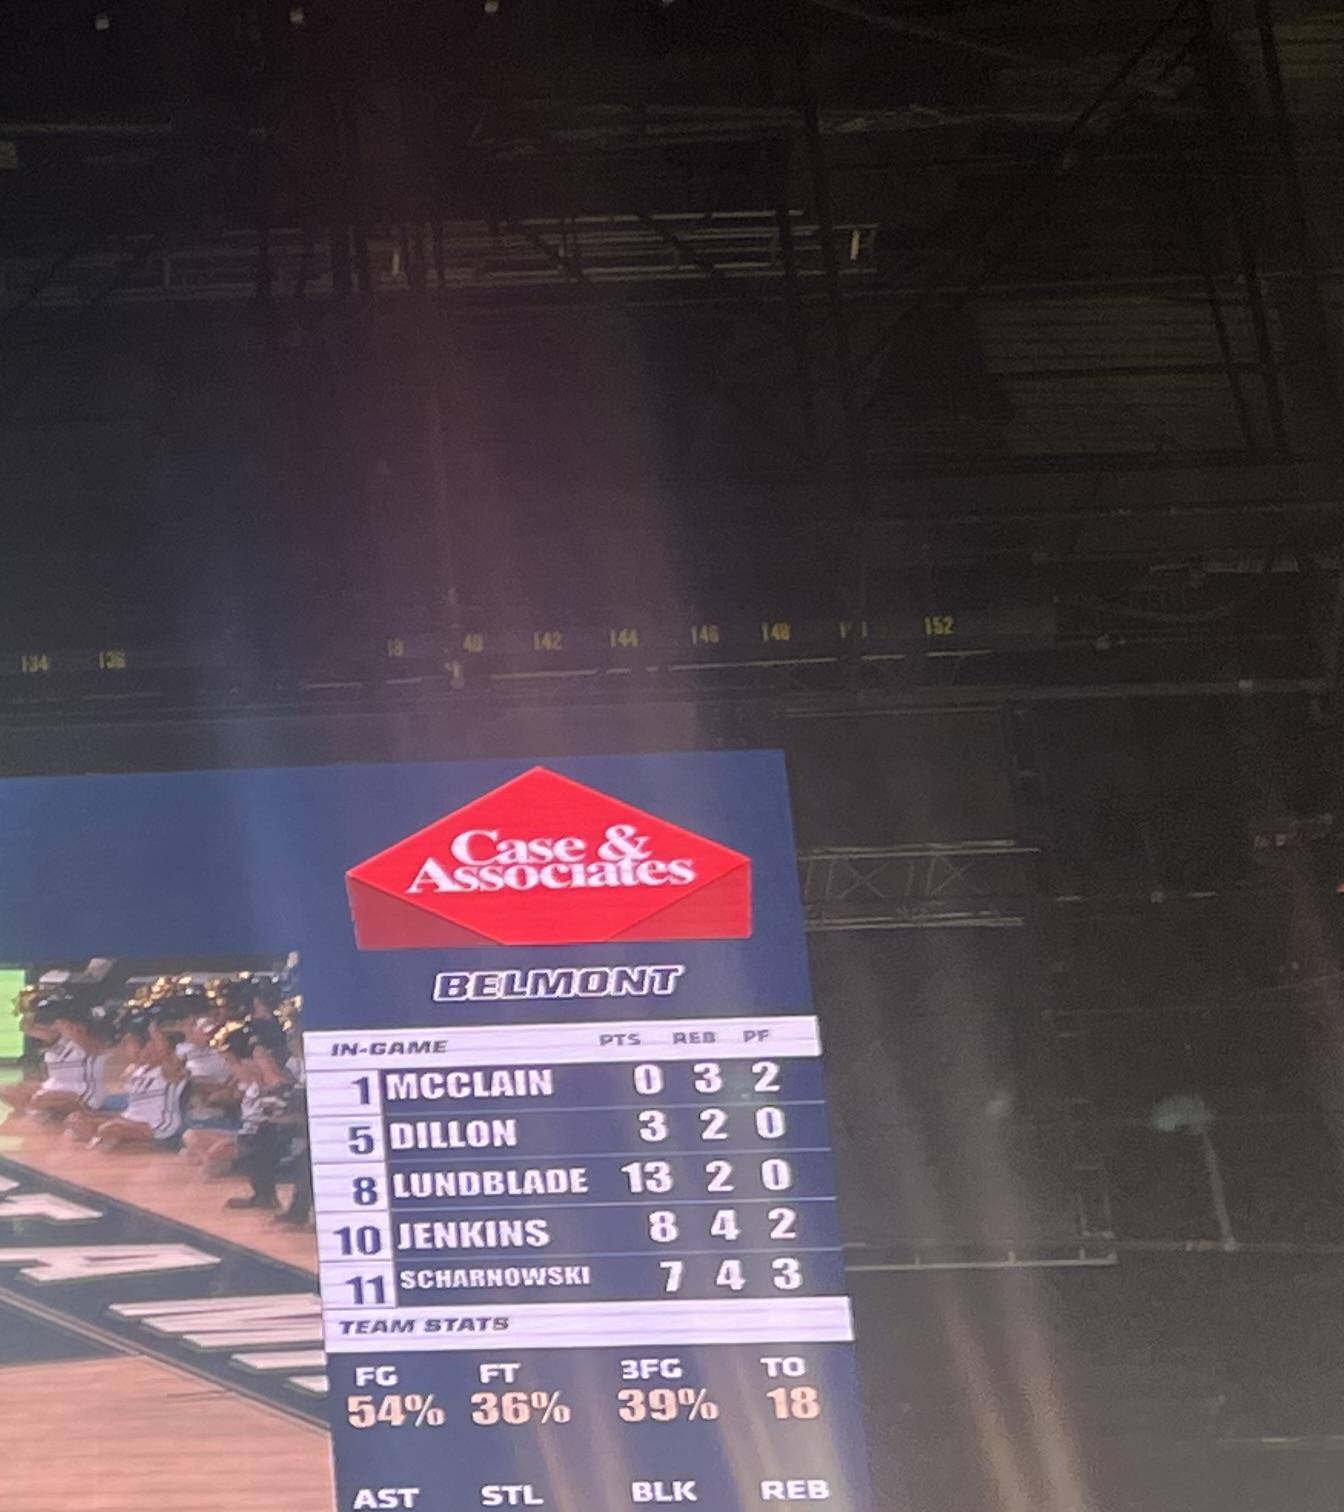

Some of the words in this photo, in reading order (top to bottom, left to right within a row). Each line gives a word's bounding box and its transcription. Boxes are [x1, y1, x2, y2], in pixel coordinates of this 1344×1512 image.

[450, 829, 585, 866] Case
[597, 824, 652, 860] &
[406, 855, 695, 893] Associates
[433, 965, 684, 1002] BELMONT
[330, 1040, 448, 1055] IN-GAME
[600, 1033, 641, 1046] PTS
[673, 1030, 716, 1044] REB
[743, 1030, 768, 1042] PF
[352, 1076, 372, 1105] 1
[385, 1069, 554, 1100] MCCLAIN
[633, 1064, 664, 1096] 0
[694, 1062, 722, 1094] 3
[751, 1061, 780, 1093] 2
[349, 1126, 374, 1155] 5
[390, 1120, 517, 1150] DILLON
[639, 1111, 668, 1142] 3
[699, 1109, 728, 1141] 2
[756, 1107, 785, 1139] 0
[352, 1177, 377, 1206] 8
[393, 1169, 588, 1199] LUNDBLADE
[622, 1161, 672, 1193] 13
[706, 1161, 735, 1192] 2
[761, 1160, 791, 1190] 0
[333, 1226, 381, 1255] 10
[397, 1220, 550, 1251] JENKINS
[649, 1211, 678, 1242] 8
[710, 1210, 739, 1241] 4
[768, 1208, 796, 1239] 2
[345, 1277, 386, 1305] 11
[400, 1266, 591, 1290] SCHARNOWSKI
[659, 1262, 684, 1292] 7
[716, 1260, 746, 1291] 4
[773, 1258, 803, 1290] 3
[339, 1319, 415, 1335] TEAM
[424, 1316, 510, 1333] STATS
[355, 1367, 397, 1387] FG
[480, 1363, 520, 1384] FT
[621, 1359, 682, 1379] 3FG
[761, 1357, 805, 1378] TO
[347, 1394, 446, 1428] 54%
[471, 1392, 571, 1425] 36%
[618, 1388, 719, 1422] 39%
[767, 1387, 820, 1420] 18
[354, 1488, 419, 1509] AST
[481, 1484, 544, 1506] STL
[632, 1481, 697, 1503] BLK
[761, 1480, 830, 1501] REB
